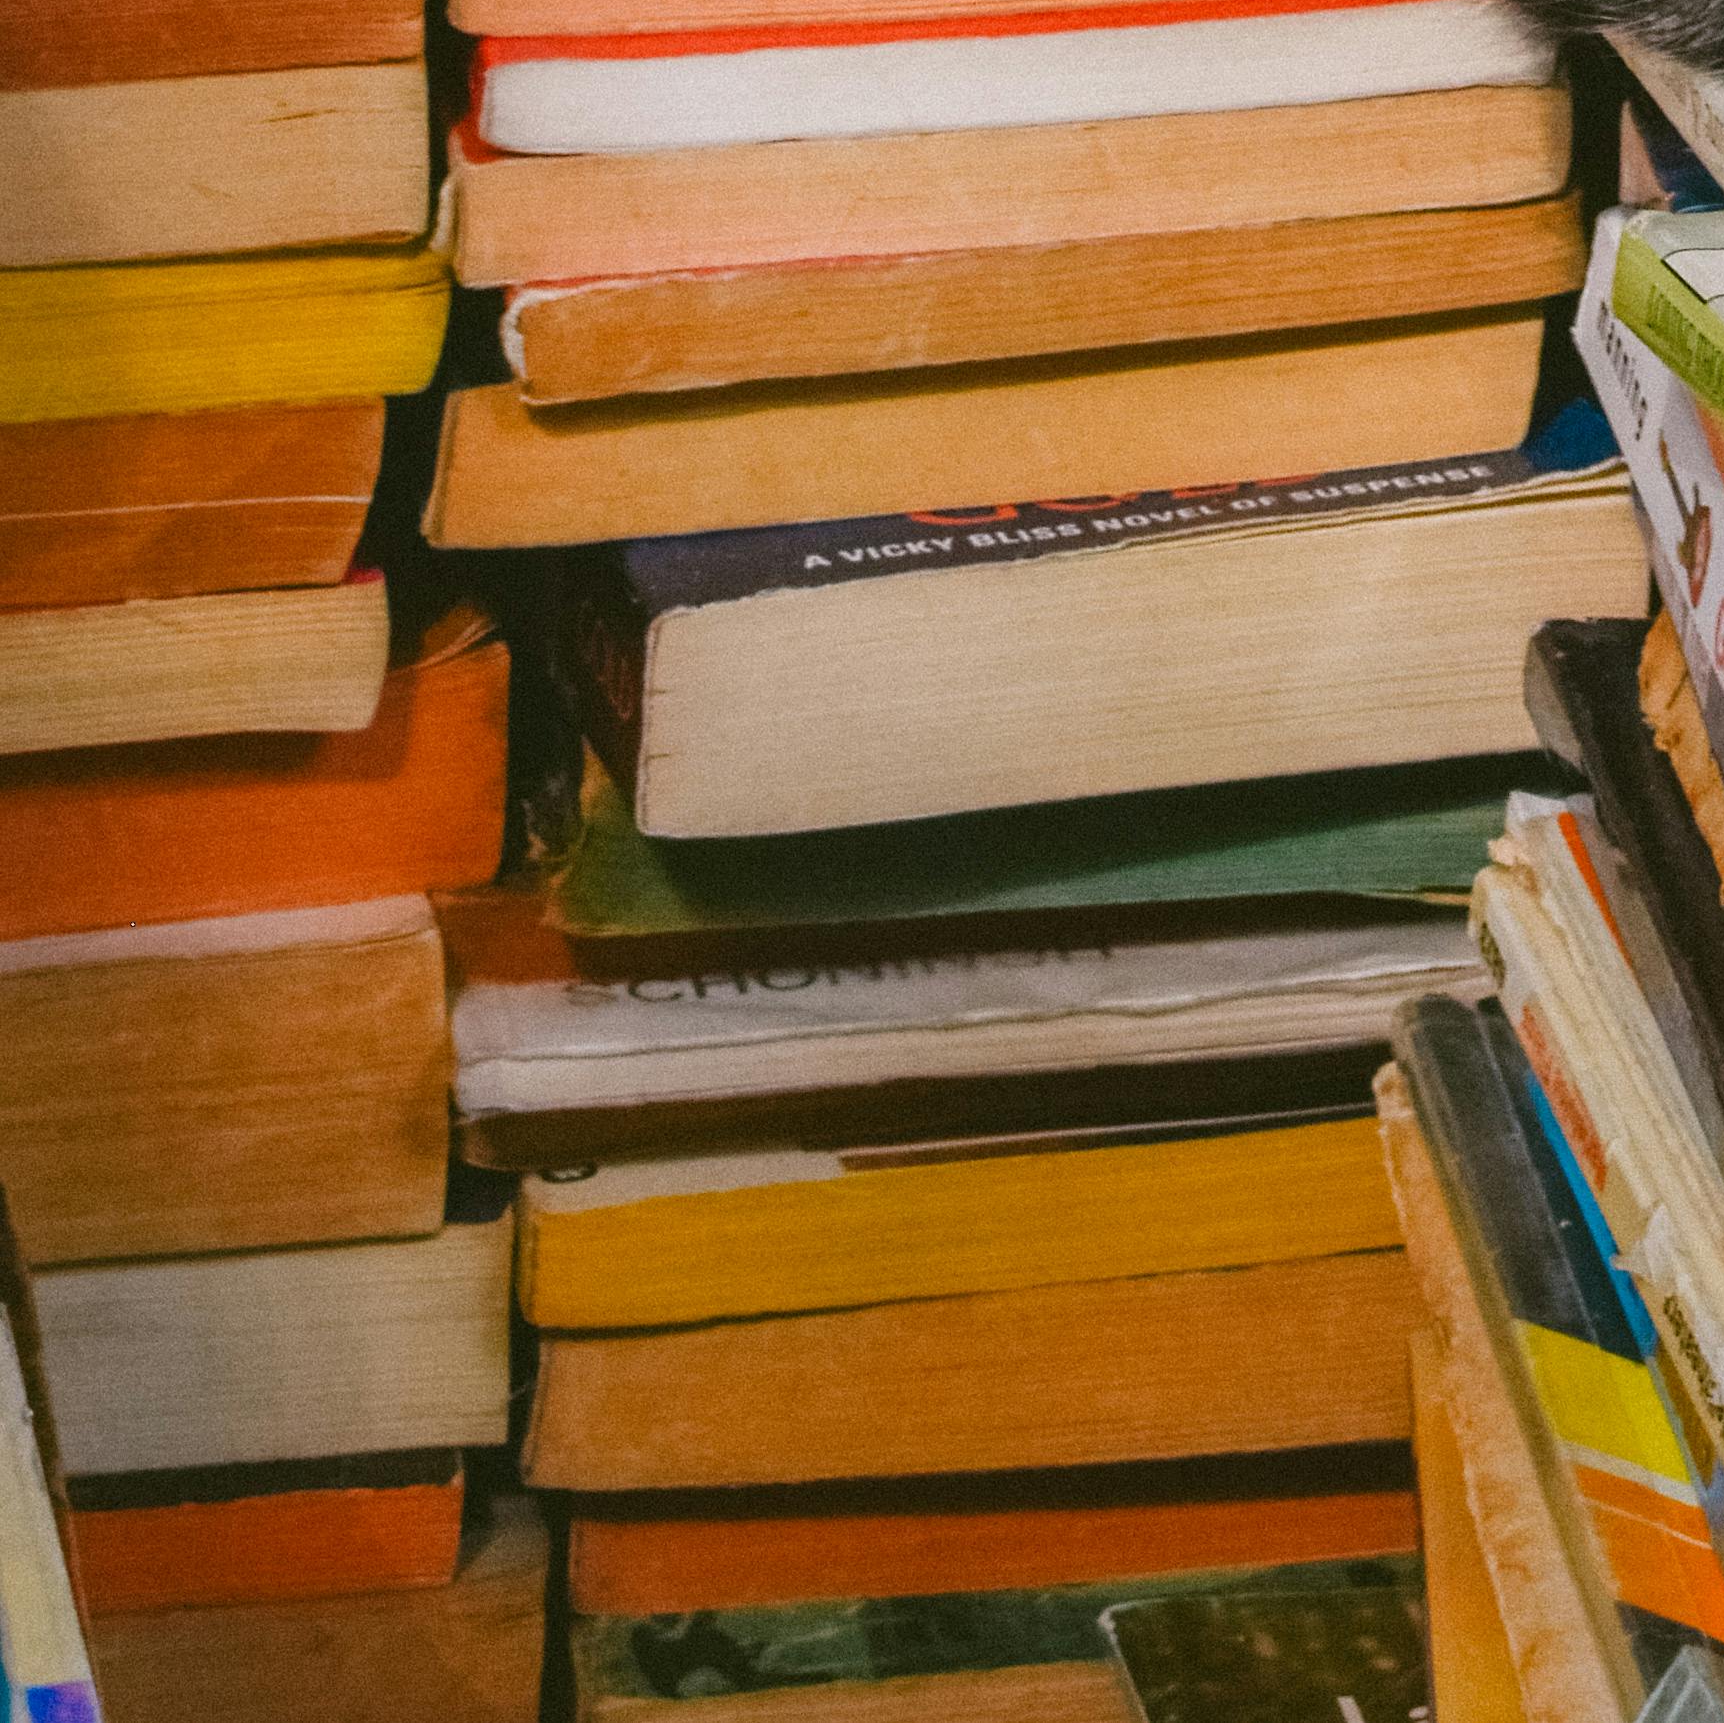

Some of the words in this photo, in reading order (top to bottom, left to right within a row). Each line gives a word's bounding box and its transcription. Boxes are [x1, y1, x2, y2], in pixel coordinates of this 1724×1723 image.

[803, 553, 833, 570] A
[837, 536, 955, 563] VICKY
[967, 522, 1083, 549] BLISS
[1091, 503, 1224, 533] NOVEL
[1229, 494, 1282, 512] OF
[1288, 464, 1496, 503] SUSPENSE
